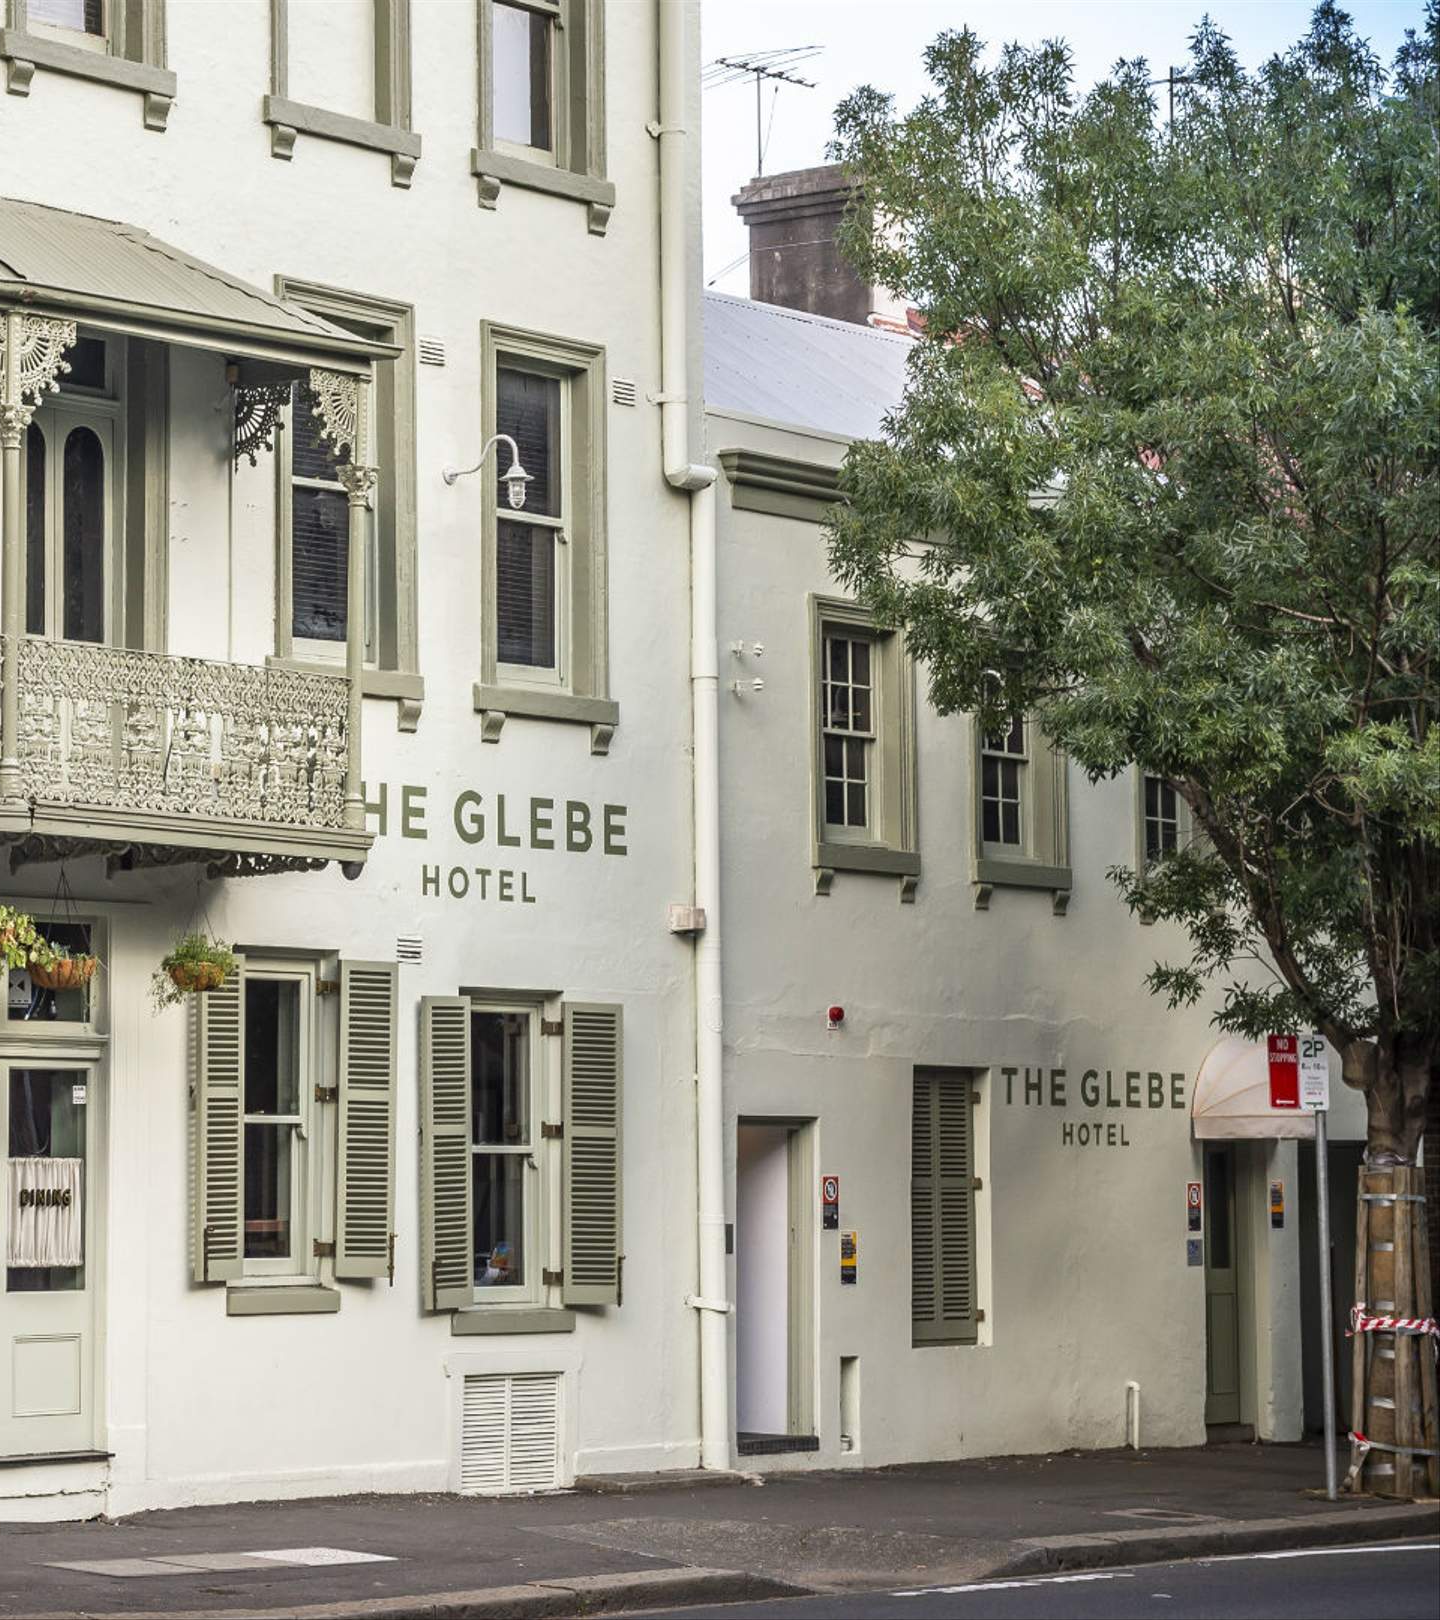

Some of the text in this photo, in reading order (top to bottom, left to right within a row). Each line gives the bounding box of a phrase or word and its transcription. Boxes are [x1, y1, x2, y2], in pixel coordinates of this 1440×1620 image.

[361, 781, 628, 856] HE GLEBE
[422, 864, 536, 903] HOTEL
[1276, 1038, 1289, 1051] NO
[1302, 1040, 1325, 1058] 2P
[1001, 1067, 1186, 1109] THE GLEBE
[1062, 1122, 1130, 1146] HOTEL
[19, 1188, 72, 1208] DINING
